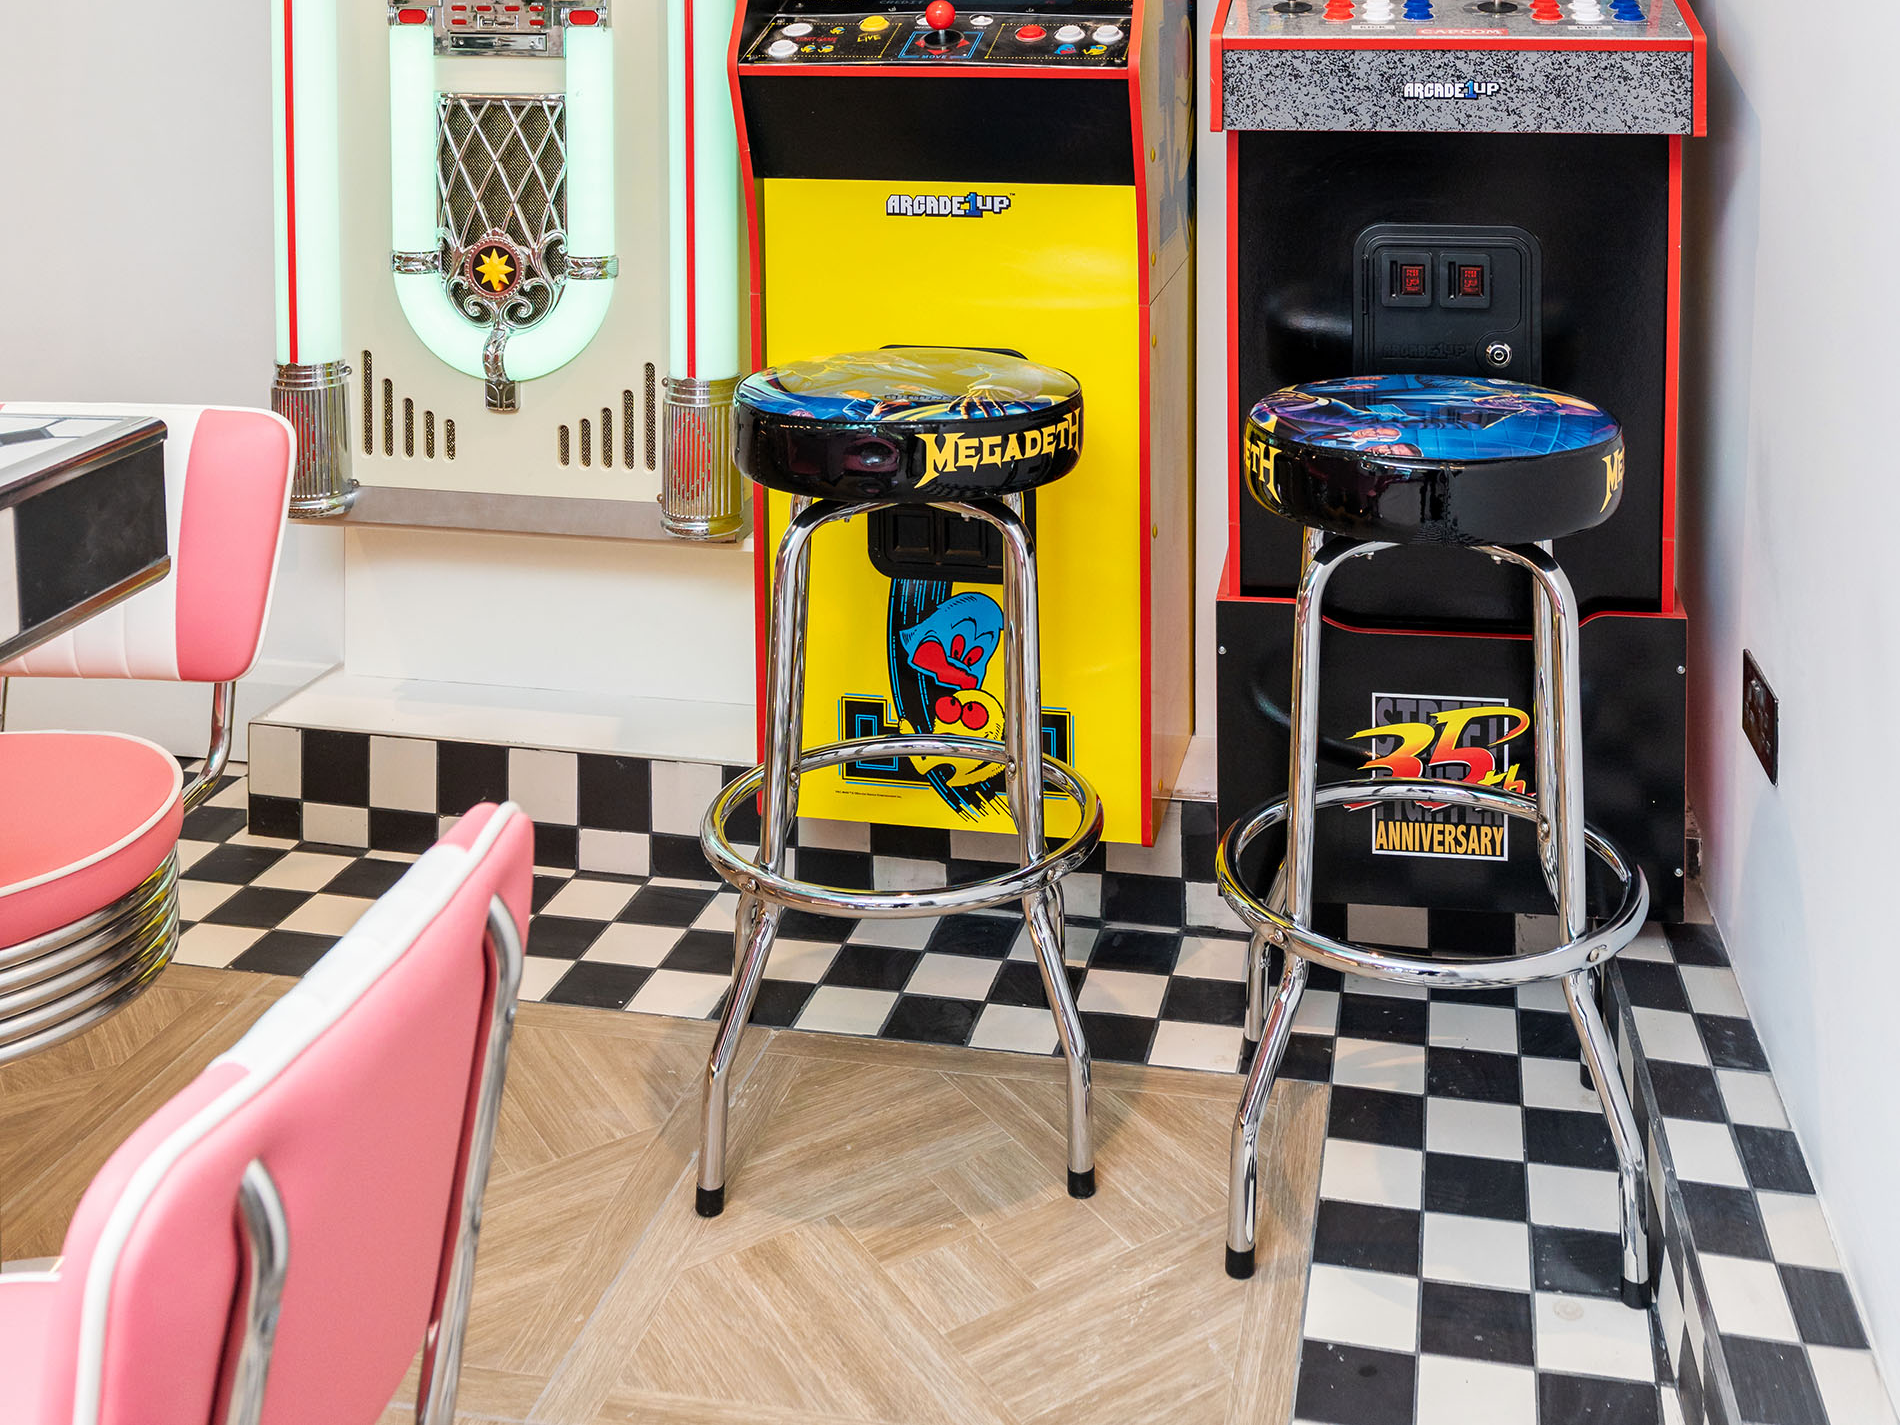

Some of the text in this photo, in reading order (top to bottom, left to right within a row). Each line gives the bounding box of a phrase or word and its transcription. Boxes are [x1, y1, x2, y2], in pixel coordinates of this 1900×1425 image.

[1403, 79, 1500, 100] ARCADE1UP
[886, 191, 1012, 218] ARCADE1UP
[914, 407, 1081, 489] MEGADETH
[1375, 820, 1504, 856] ANNIVERSARY
